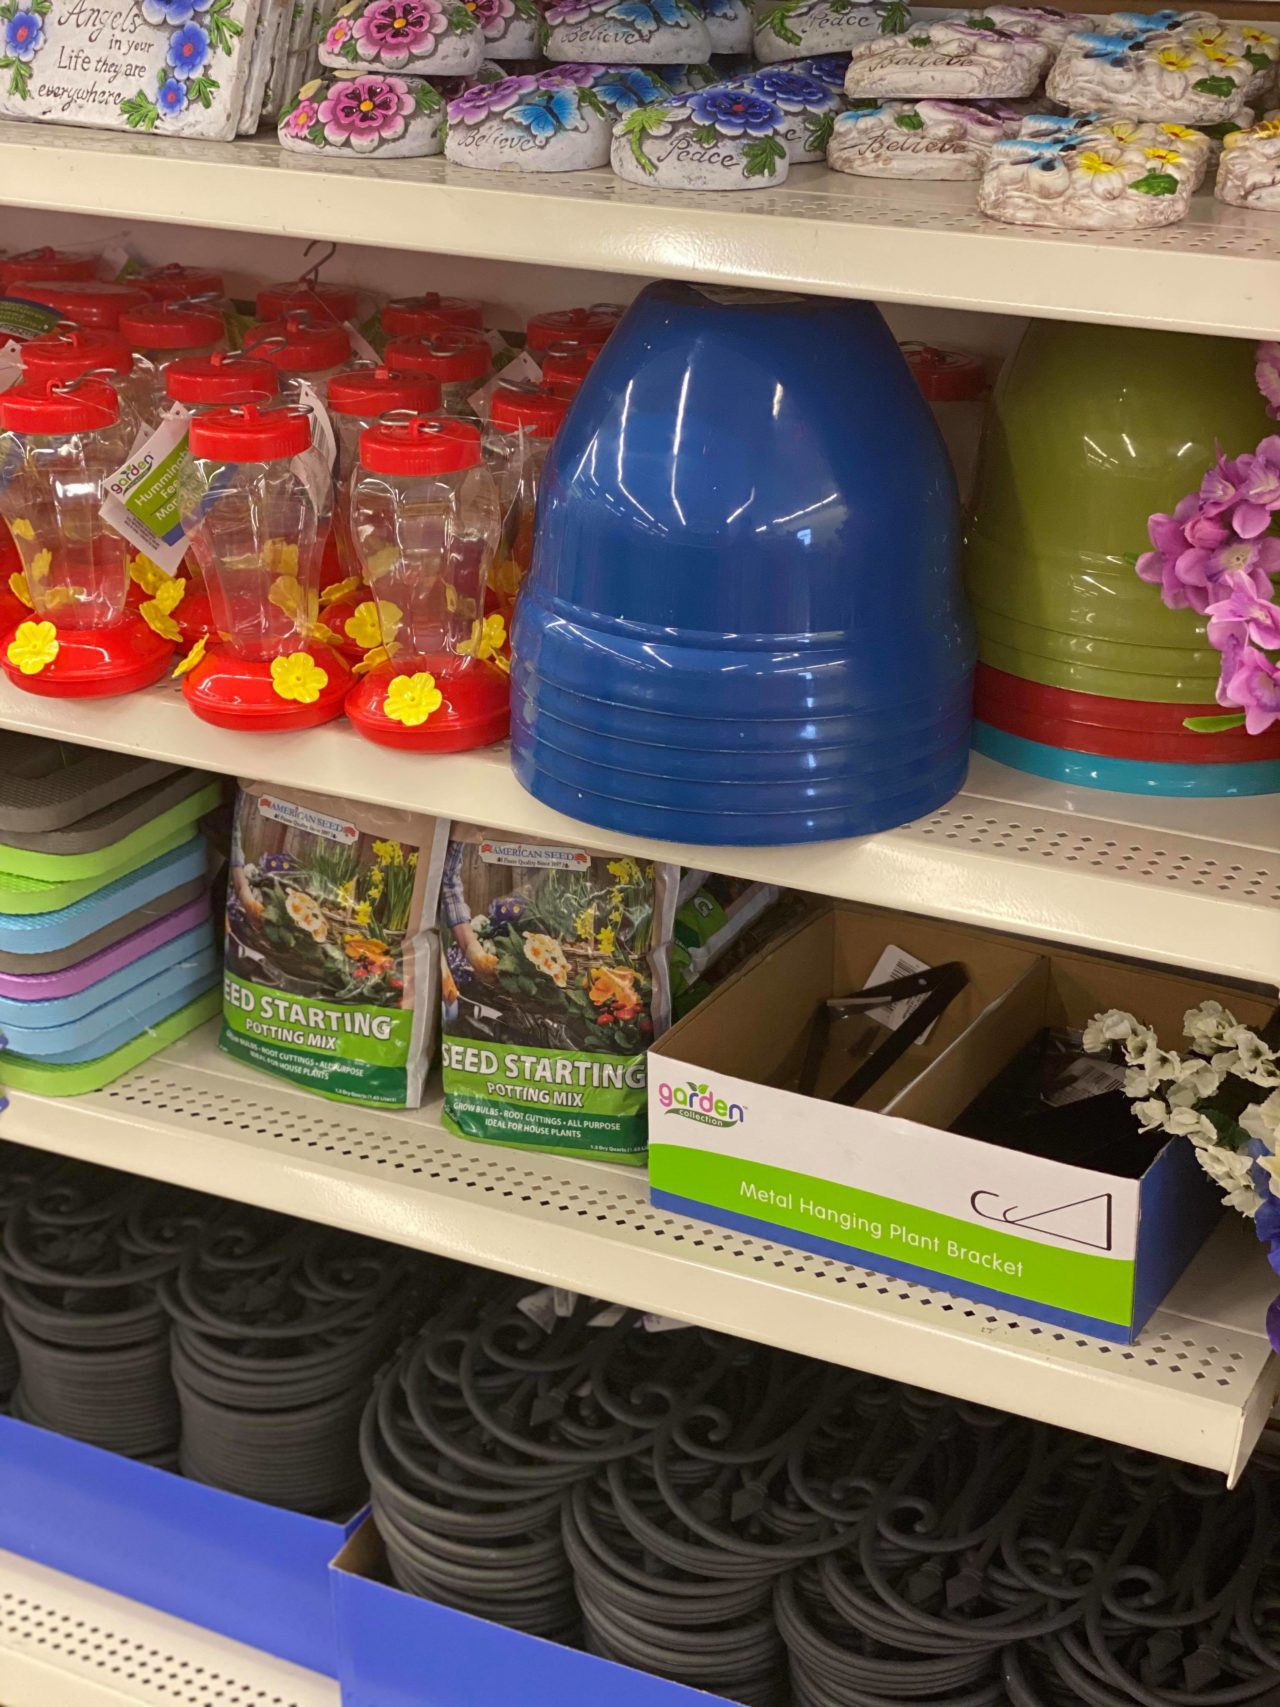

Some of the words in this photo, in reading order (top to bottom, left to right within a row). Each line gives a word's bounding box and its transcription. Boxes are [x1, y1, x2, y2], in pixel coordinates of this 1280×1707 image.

[58, 0, 145, 42] Angels
[810, 12, 875, 28] Peace
[108, 34, 122, 50] in
[123, 40, 155, 56] your
[57, 45, 91, 72] Life
[94, 55, 122, 84] they
[124, 62, 147, 78] are
[38, 81, 126, 112] everywhere
[457, 127, 538, 151] Believe
[657, 135, 741, 169] Peace
[858, 130, 968, 156] Believe
[110, 453, 154, 495] garden
[271, 803, 317, 824] AMERICAN
[316, 817, 344, 833] SEED
[495, 846, 543, 858] AMERICAN
[544, 850, 574, 861] SEED
[223, 977, 256, 1012] EED
[259, 994, 393, 1041] STARTING
[245, 1018, 305, 1046] POTTING
[307, 1032, 338, 1050] MIX
[261, 1046, 278, 1058] ROOT
[279, 1052, 315, 1067] CUTTINGS
[279, 1060, 302, 1075] HOUSE
[303, 1067, 330, 1081] PLANTS
[442, 1043, 499, 1075] SEED
[503, 1052, 647, 1090] STARTING
[486, 1081, 550, 1104] POTTING
[552, 1091, 584, 1108] MIX
[658, 1082, 744, 1123] garden
[453, 1101, 476, 1115] GROW
[476, 1103, 499, 1117] BULBS
[503, 1110, 524, 1121] ROOT
[525, 1112, 562, 1127] CUTTINGS
[567, 1119, 582, 1129] ALL
[583, 1120, 621, 1131] PURPOSE
[485, 1118, 506, 1130] IDEAL
[507, 1121, 523, 1132] FOR
[523, 1124, 550, 1136] HOUSE
[551, 1128, 582, 1139] PLANTS
[678, 1108, 724, 1127] collection
[740, 1180, 793, 1210] Metal
[799, 1197, 882, 1239] Hanging
[889, 1223, 940, 1253] Plant
[947, 1240, 1023, 1278] Bracket
